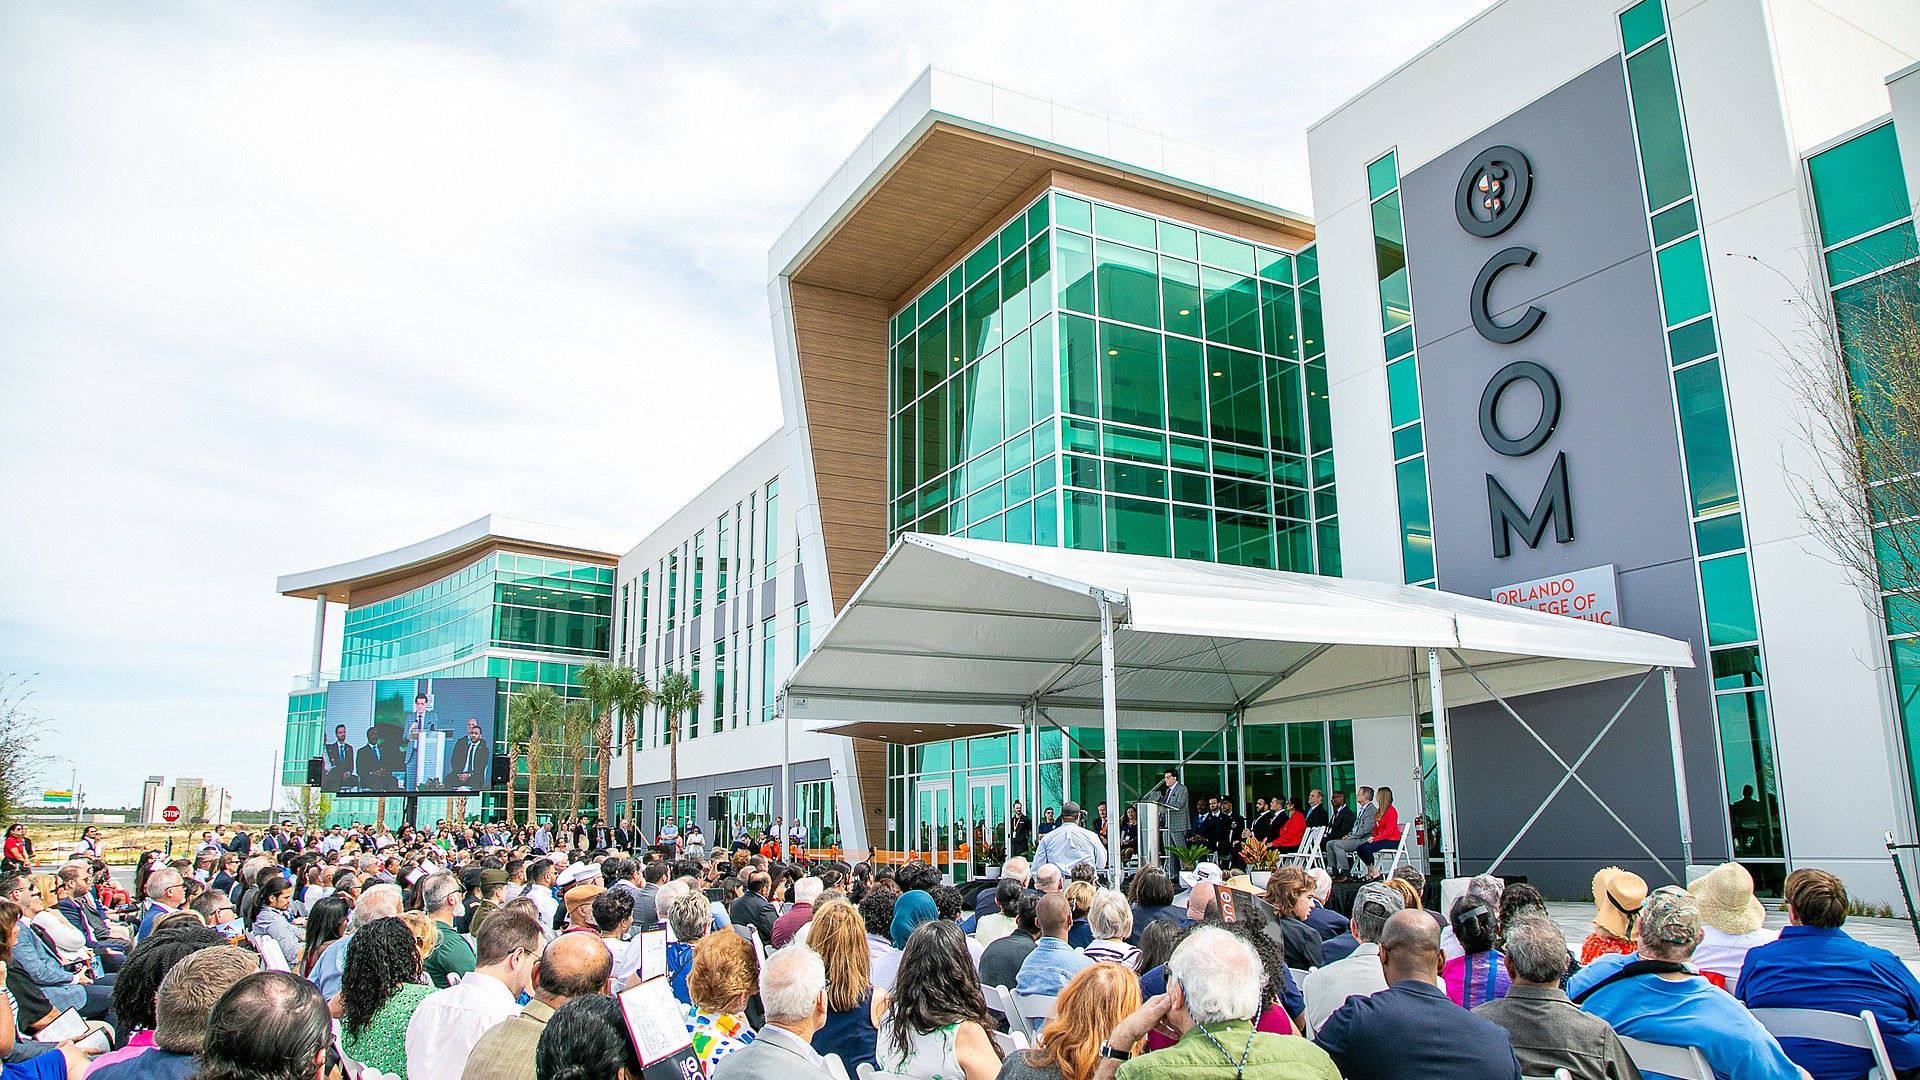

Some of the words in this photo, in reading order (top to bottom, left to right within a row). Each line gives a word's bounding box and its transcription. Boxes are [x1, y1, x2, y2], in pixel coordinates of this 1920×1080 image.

[1454, 143, 1575, 559] OCOM
[1496, 578, 1575, 605] ORLANDO
[1573, 593, 1596, 611] OF
[163, 810, 180, 818] STOP
